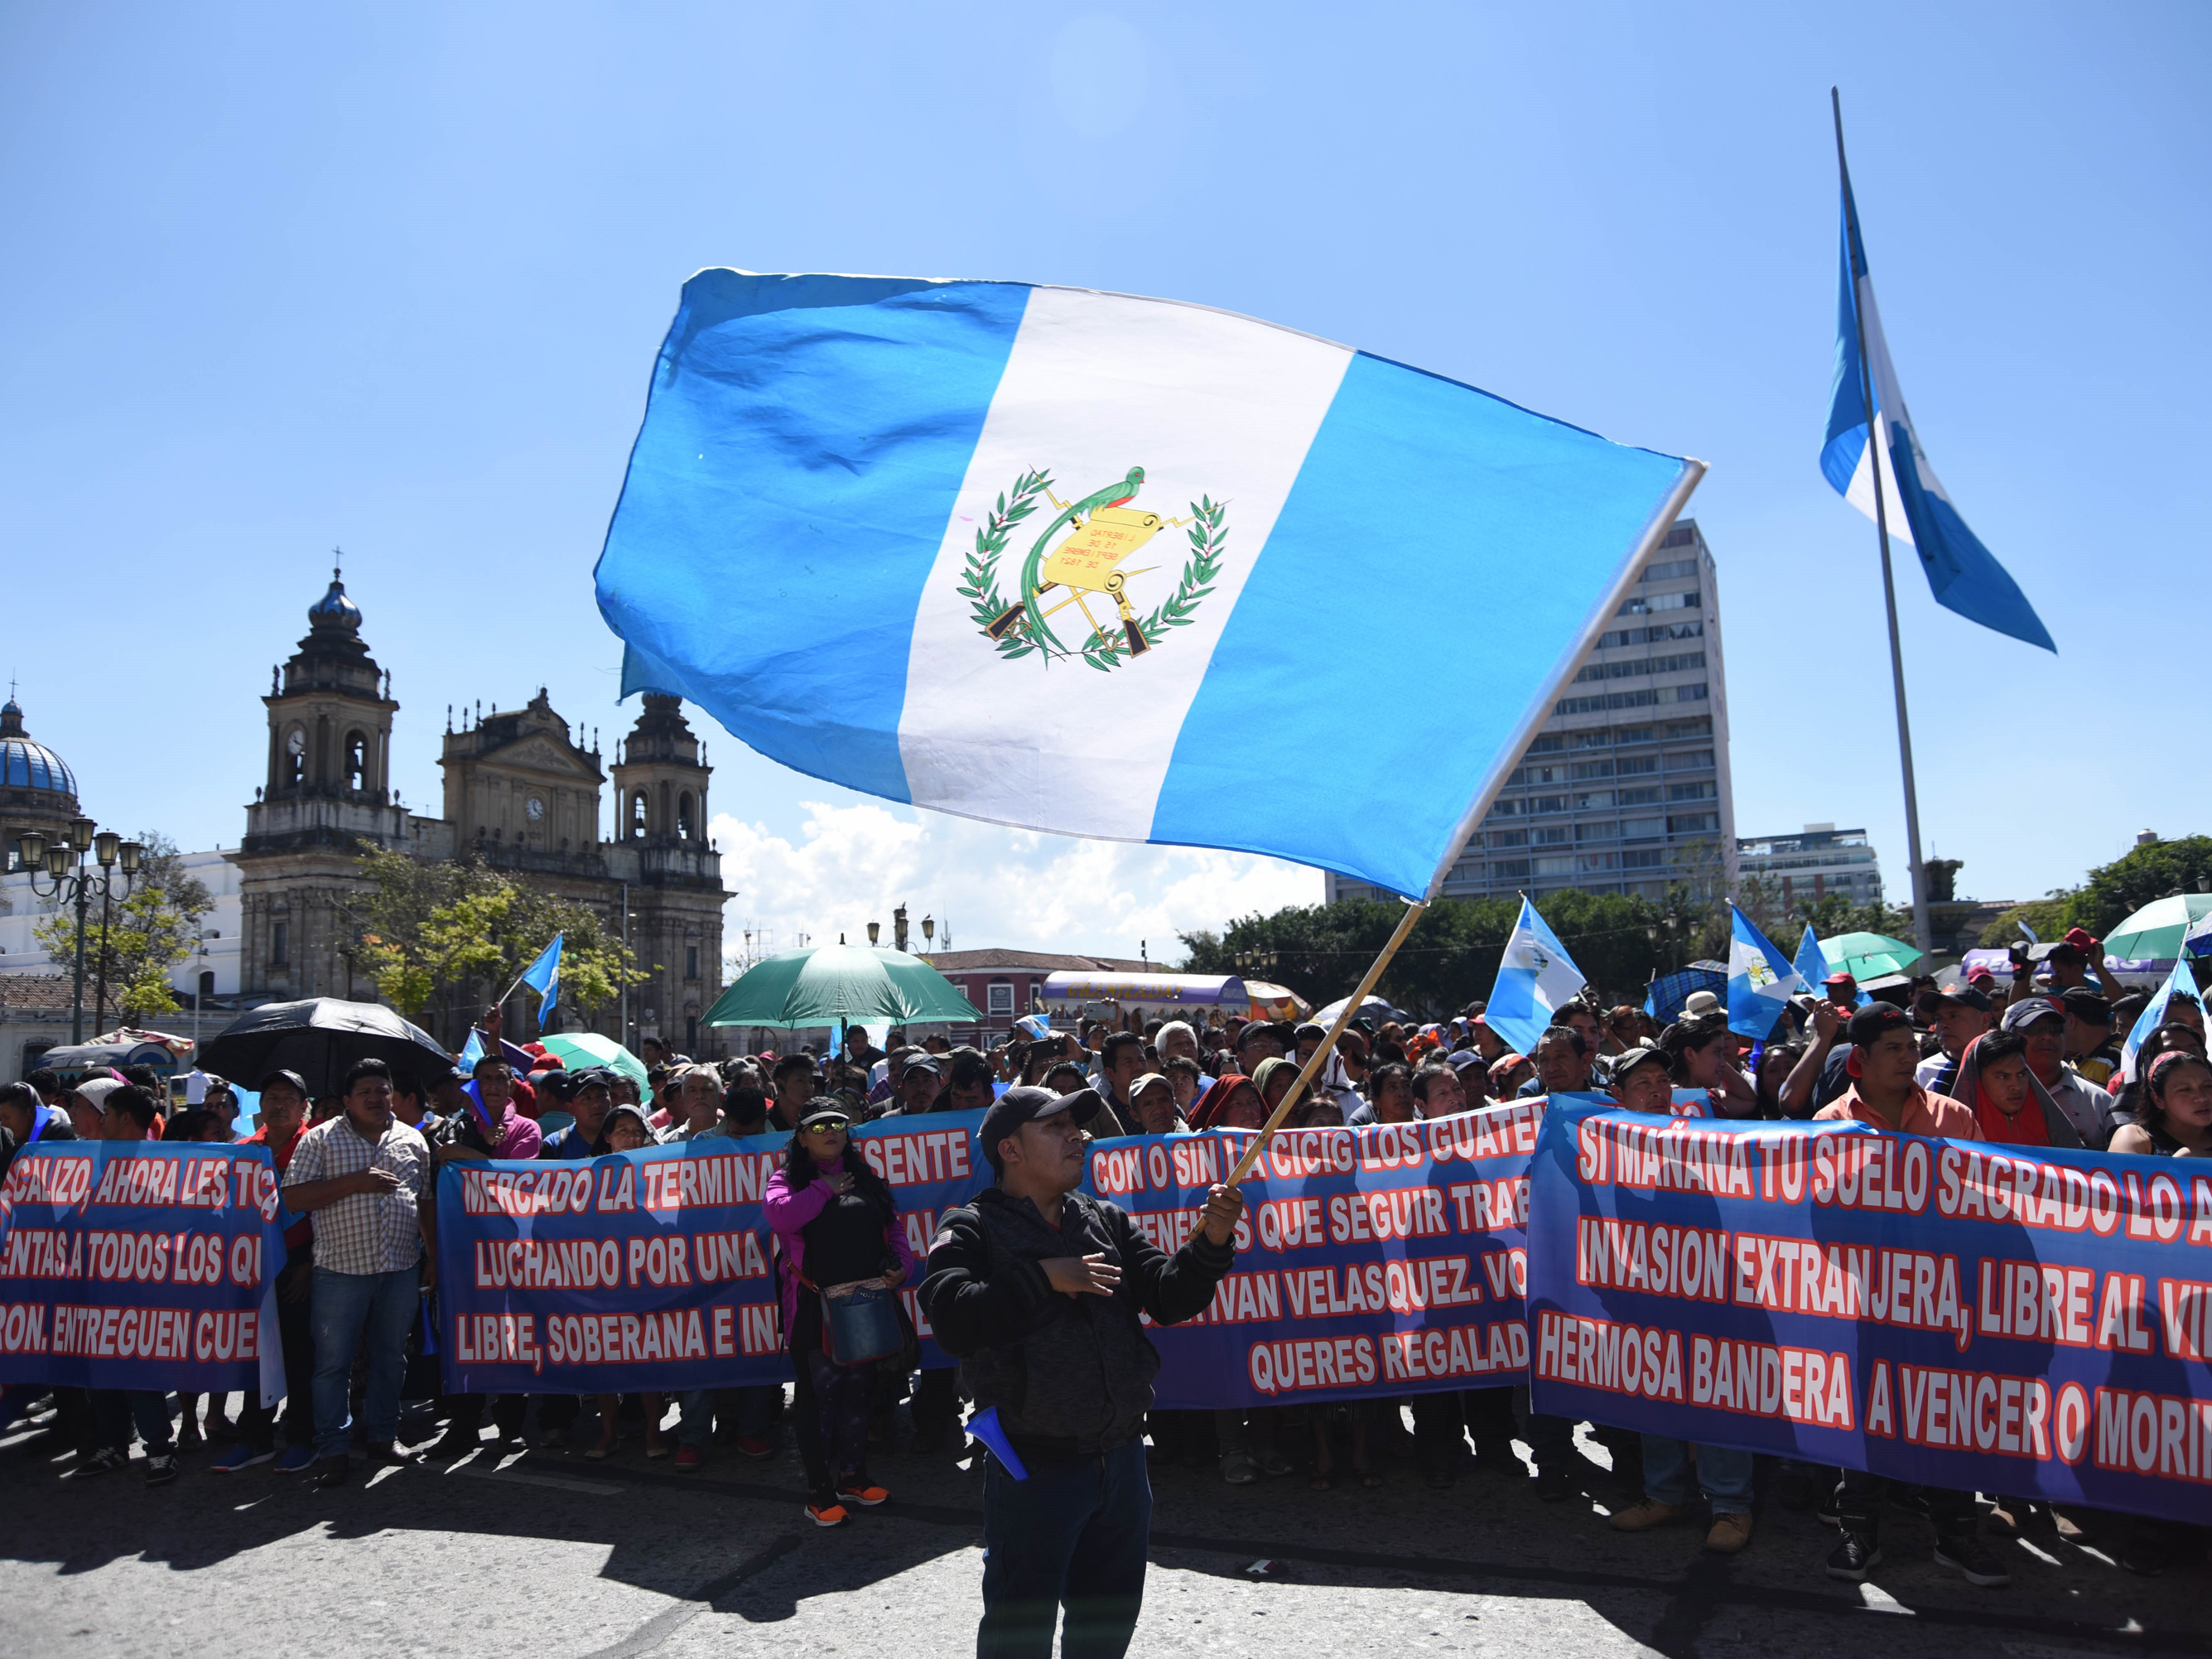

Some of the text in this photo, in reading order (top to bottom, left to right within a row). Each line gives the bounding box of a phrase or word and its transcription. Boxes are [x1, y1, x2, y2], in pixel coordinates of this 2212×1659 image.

[94, 1159, 179, 1205] AHORA
[181, 1160, 229, 1207] LES
[460, 1130, 970, 1215] MERCADO LA TERMINA SENTE
[1092, 1147, 1145, 1194] CON
[1148, 1145, 1169, 1189] O
[1173, 1138, 1222, 1189] SIN
[1270, 1126, 1354, 1177] CICIG
[1360, 1126, 1423, 1170] LOS
[1578, 1116, 1609, 1182] SI
[1617, 1120, 1752, 1199] MAÑANA
[1757, 1133, 1807, 1201] TU
[1814, 1134, 1929, 1212] SUELO
[1938, 1147, 2120, 1233] SAGRADO
[2127, 1173, 2181, 1240] LO
[1258, 1198, 1324, 1251] QUE
[1329, 1188, 1448, 1242] SEGUIR
[69, 1232, 83, 1277] A
[88, 1232, 170, 1281] TODOS
[173, 1234, 223, 1284] LOS
[476, 1239, 620, 1287] LUCHANDO
[629, 1237, 691, 1285] POR
[696, 1231, 767, 1282] UNA
[1210, 1271, 1280, 1324] IVAN
[1284, 1257, 1481, 1316] VELASQUEZ.
[1579, 1218, 1727, 1300] INVASION
[1734, 1235, 1969, 1352] EXTRANJERA,
[1980, 1261, 2090, 1343] LIBRE
[2098, 1275, 2149, 1351] AL
[52, 1305, 191, 1358] ENTREGUEN
[195, 1309, 259, 1360] CUE
[458, 1315, 542, 1372] LIBRE,
[547, 1309, 707, 1362] SOBERANA
[714, 1307, 735, 1356] E
[1251, 1337, 1376, 1392] QUERES
[1538, 1313, 1684, 1401] HERMOSA
[1692, 1337, 1851, 1426] BANDERA
[1867, 1362, 1892, 1435] A
[1901, 1367, 2047, 1456] VENCER
[2058, 1385, 2086, 1461] O
